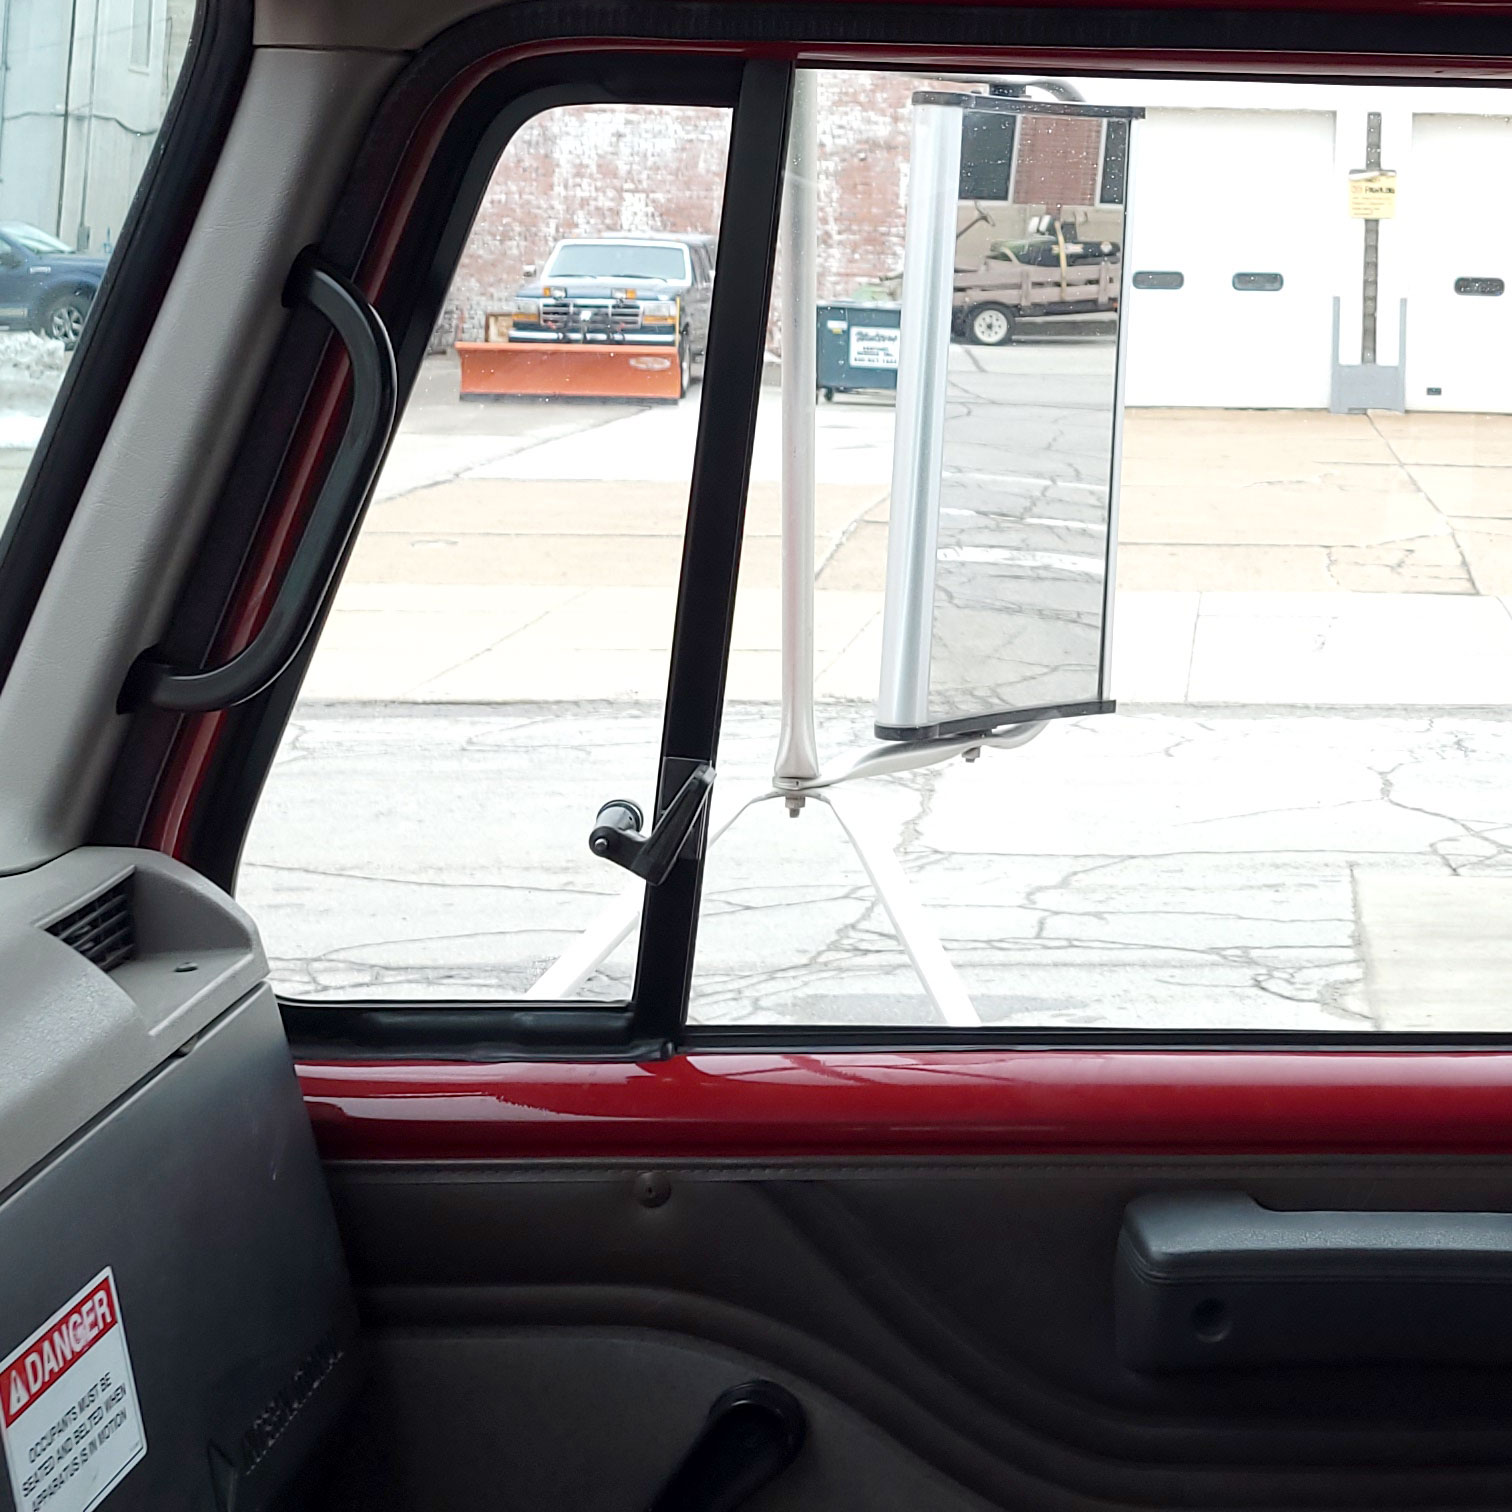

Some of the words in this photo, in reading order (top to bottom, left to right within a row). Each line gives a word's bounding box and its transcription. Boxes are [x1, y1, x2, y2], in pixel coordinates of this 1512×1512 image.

[24, 1289, 112, 1395] DANGER
[22, 1455, 55, 1498] SEATED
[56, 1437, 73, 1464] AND
[73, 1406, 104, 1445] BELTED
[105, 1383, 127, 1414] WHEN
[29, 1406, 78, 1463] OCCUPANTS
[78, 1383, 99, 1414] MUST
[99, 1371, 112, 1392] BE
[32, 1456, 80, 1512] APPARATUS
[80, 1448, 88, 1468] IS
[88, 1441, 98, 1460] IN
[98, 1407, 127, 1448] MOTION
